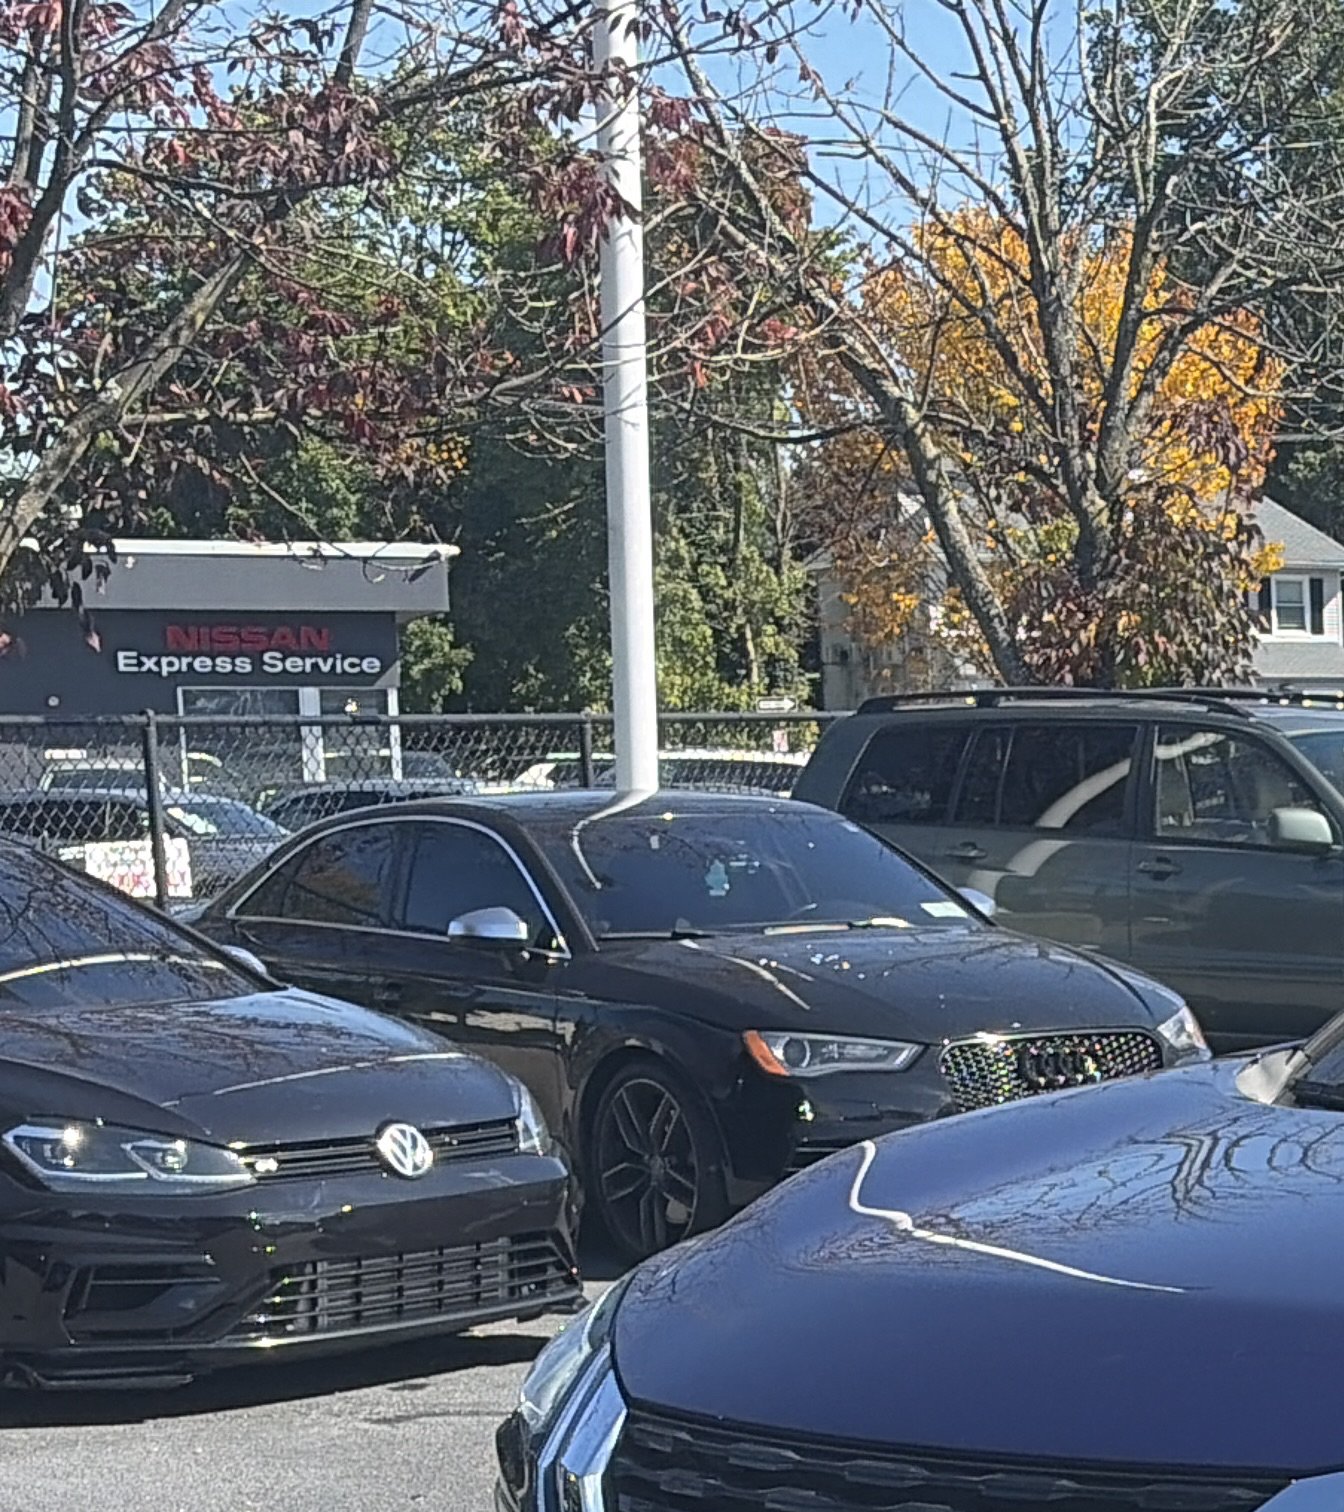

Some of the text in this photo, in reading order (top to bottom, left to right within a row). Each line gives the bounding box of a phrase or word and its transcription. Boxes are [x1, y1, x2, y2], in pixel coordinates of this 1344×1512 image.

[166, 625, 330, 651] NISSAN
[116, 650, 382, 677] Express Service
